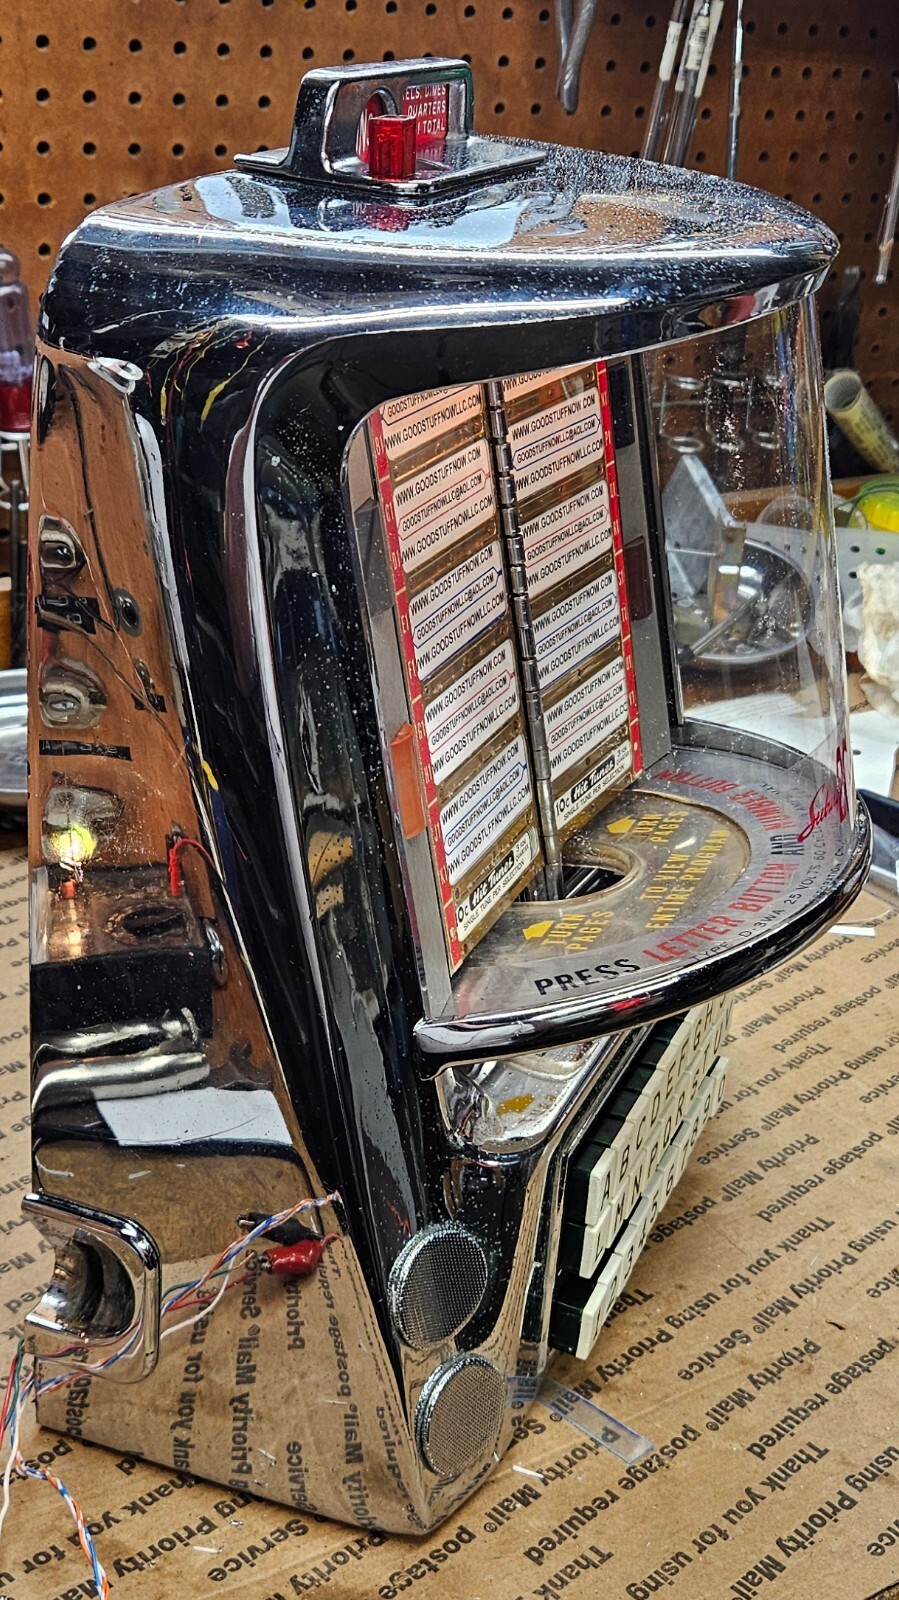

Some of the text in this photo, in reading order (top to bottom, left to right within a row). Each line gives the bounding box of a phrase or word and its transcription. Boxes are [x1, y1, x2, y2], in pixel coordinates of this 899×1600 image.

[407, 100, 446, 118] QUARTERS
[423, 118, 445, 134] TOTAL
[511, 393, 596, 441] WWW.GOODSTUFFNOW.COM
[395, 446, 482, 507] WWW.GOODSTUFFNOW.COM
[522, 484, 604, 539] WWW.GOODSTUFFNOW.COM
[410, 545, 494, 617] WWW.GOODSTUFFNOW.COM
[532, 573, 613, 634] WWW.GOODSTUFFNOW.COM
[425, 648, 507, 724] WWW.GOODSTUFFNOW.COM
[546, 661, 624, 724] WWW.GOODSTUFFNOW.COM
[440, 741, 520, 826] WWW.GOODSTUFFNOW.COM
[649, 810, 690, 843] PAGES
[640, 853, 691, 900] TO VIEW
[645, 829, 731, 929] ENTIRE PROGRAM
[534, 958, 641, 996] PRESS
[642, 914, 746, 963] LETTER
[728, 862, 798, 913] BUTTON
[769, 833, 805, 855] AND
[542, 913, 587, 946] TURN
[565, 910, 615, 951] PAGES
[689, 940, 730, 962] TYPE
[796, 864, 822, 890] VOLTS
[803, 935, 855, 962] Priority
[773, 985, 826, 1016] Priority
[829, 984, 883, 1019] postage
[771, 1015, 832, 1054] required
[843, 1045, 887, 1071] using
[666, 1062, 676, 1100] E
[732, 1042, 833, 1103] Thank you for
[793, 1069, 853, 1105] Priority
[650, 1090, 661, 1127] D
[636, 1116, 646, 1150] C
[697, 1127, 760, 1165] Service
[756, 1133, 821, 1172] Priority
[619, 1144, 630, 1182] B
[665, 1163, 675, 1196] 6
[756, 1131, 885, 1223] postage required
[600, 1169, 611, 1211] A
[649, 1195, 718, 1243] postage
[777, 1215, 835, 1253] Thank
[847, 1218, 899, 1252] using
[624, 1244, 634, 1280] 3
[720, 1272, 752, 1295] for
[745, 1248, 781, 1276] you
[789, 1251, 859, 1299] Priority
[664, 1291, 721, 1330] using
[595, 1327, 674, 1383] Priority
[677, 1328, 753, 1381] Service
[746, 1337, 822, 1391] Priority
[746, 1336, 897, 1461] postage required
[536, 1425, 622, 1487] Priority
[617, 1423, 702, 1491] postage
[844, 1445, 899, 1493] using
[523, 1488, 621, 1567] required
[625, 1440, 831, 1600] Thank you for using
[775, 1489, 859, 1558] Priority
[22, 1544, 66, 1574] for
[112, 1515, 218, 1578] Priority
[207, 1518, 310, 1582] Service
[288, 1528, 391, 1596] Priority
[378, 1524, 478, 1600] postage
[532, 1544, 615, 1600] Thank
